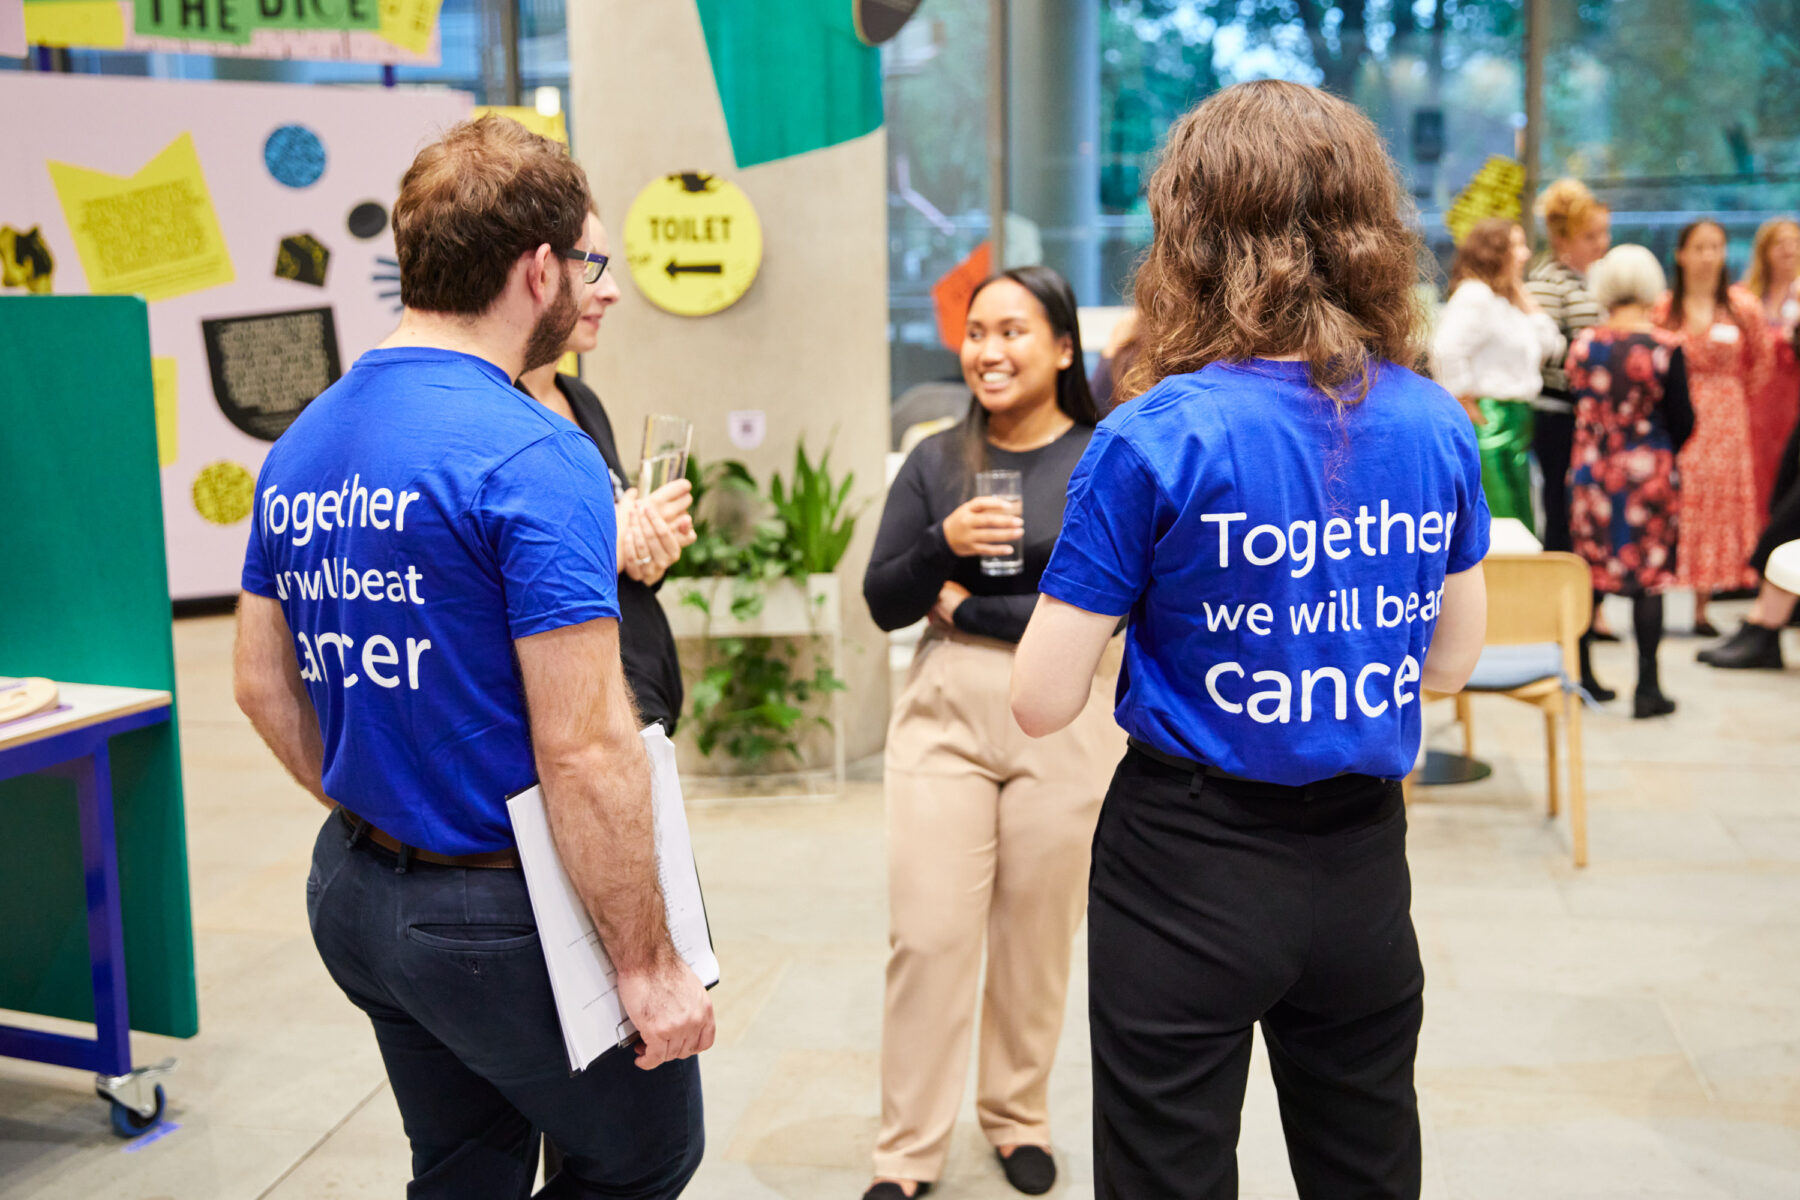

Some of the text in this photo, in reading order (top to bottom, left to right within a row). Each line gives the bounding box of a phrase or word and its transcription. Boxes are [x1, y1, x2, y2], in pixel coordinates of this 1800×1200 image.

[649, 216, 733, 242] TOILET
[262, 473, 420, 547] Together
[1200, 498, 1457, 579] Together
[342, 557, 425, 605] beat
[1202, 602, 1274, 636] we
[1290, 588, 1363, 636] will
[298, 631, 432, 690] ancer
[1204, 647, 1427, 724] cance
